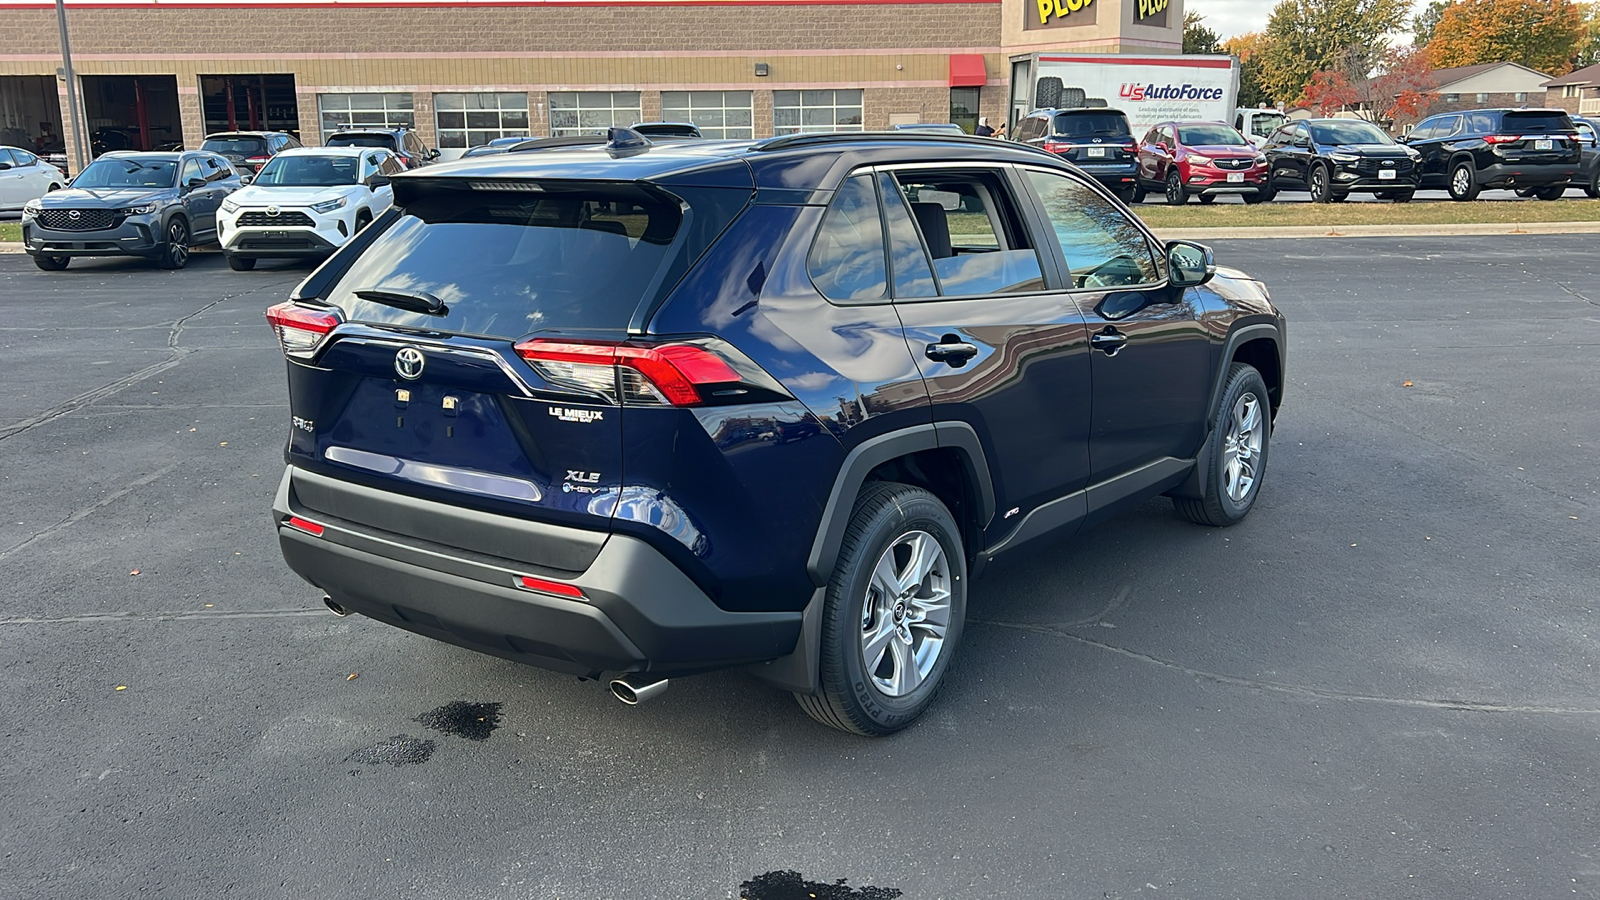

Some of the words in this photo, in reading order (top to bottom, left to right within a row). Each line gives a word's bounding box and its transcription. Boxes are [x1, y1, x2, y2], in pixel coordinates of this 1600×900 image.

[549, 407, 562, 416] LE
[565, 409, 603, 420] MIEUX
[564, 470, 601, 483] XLE
